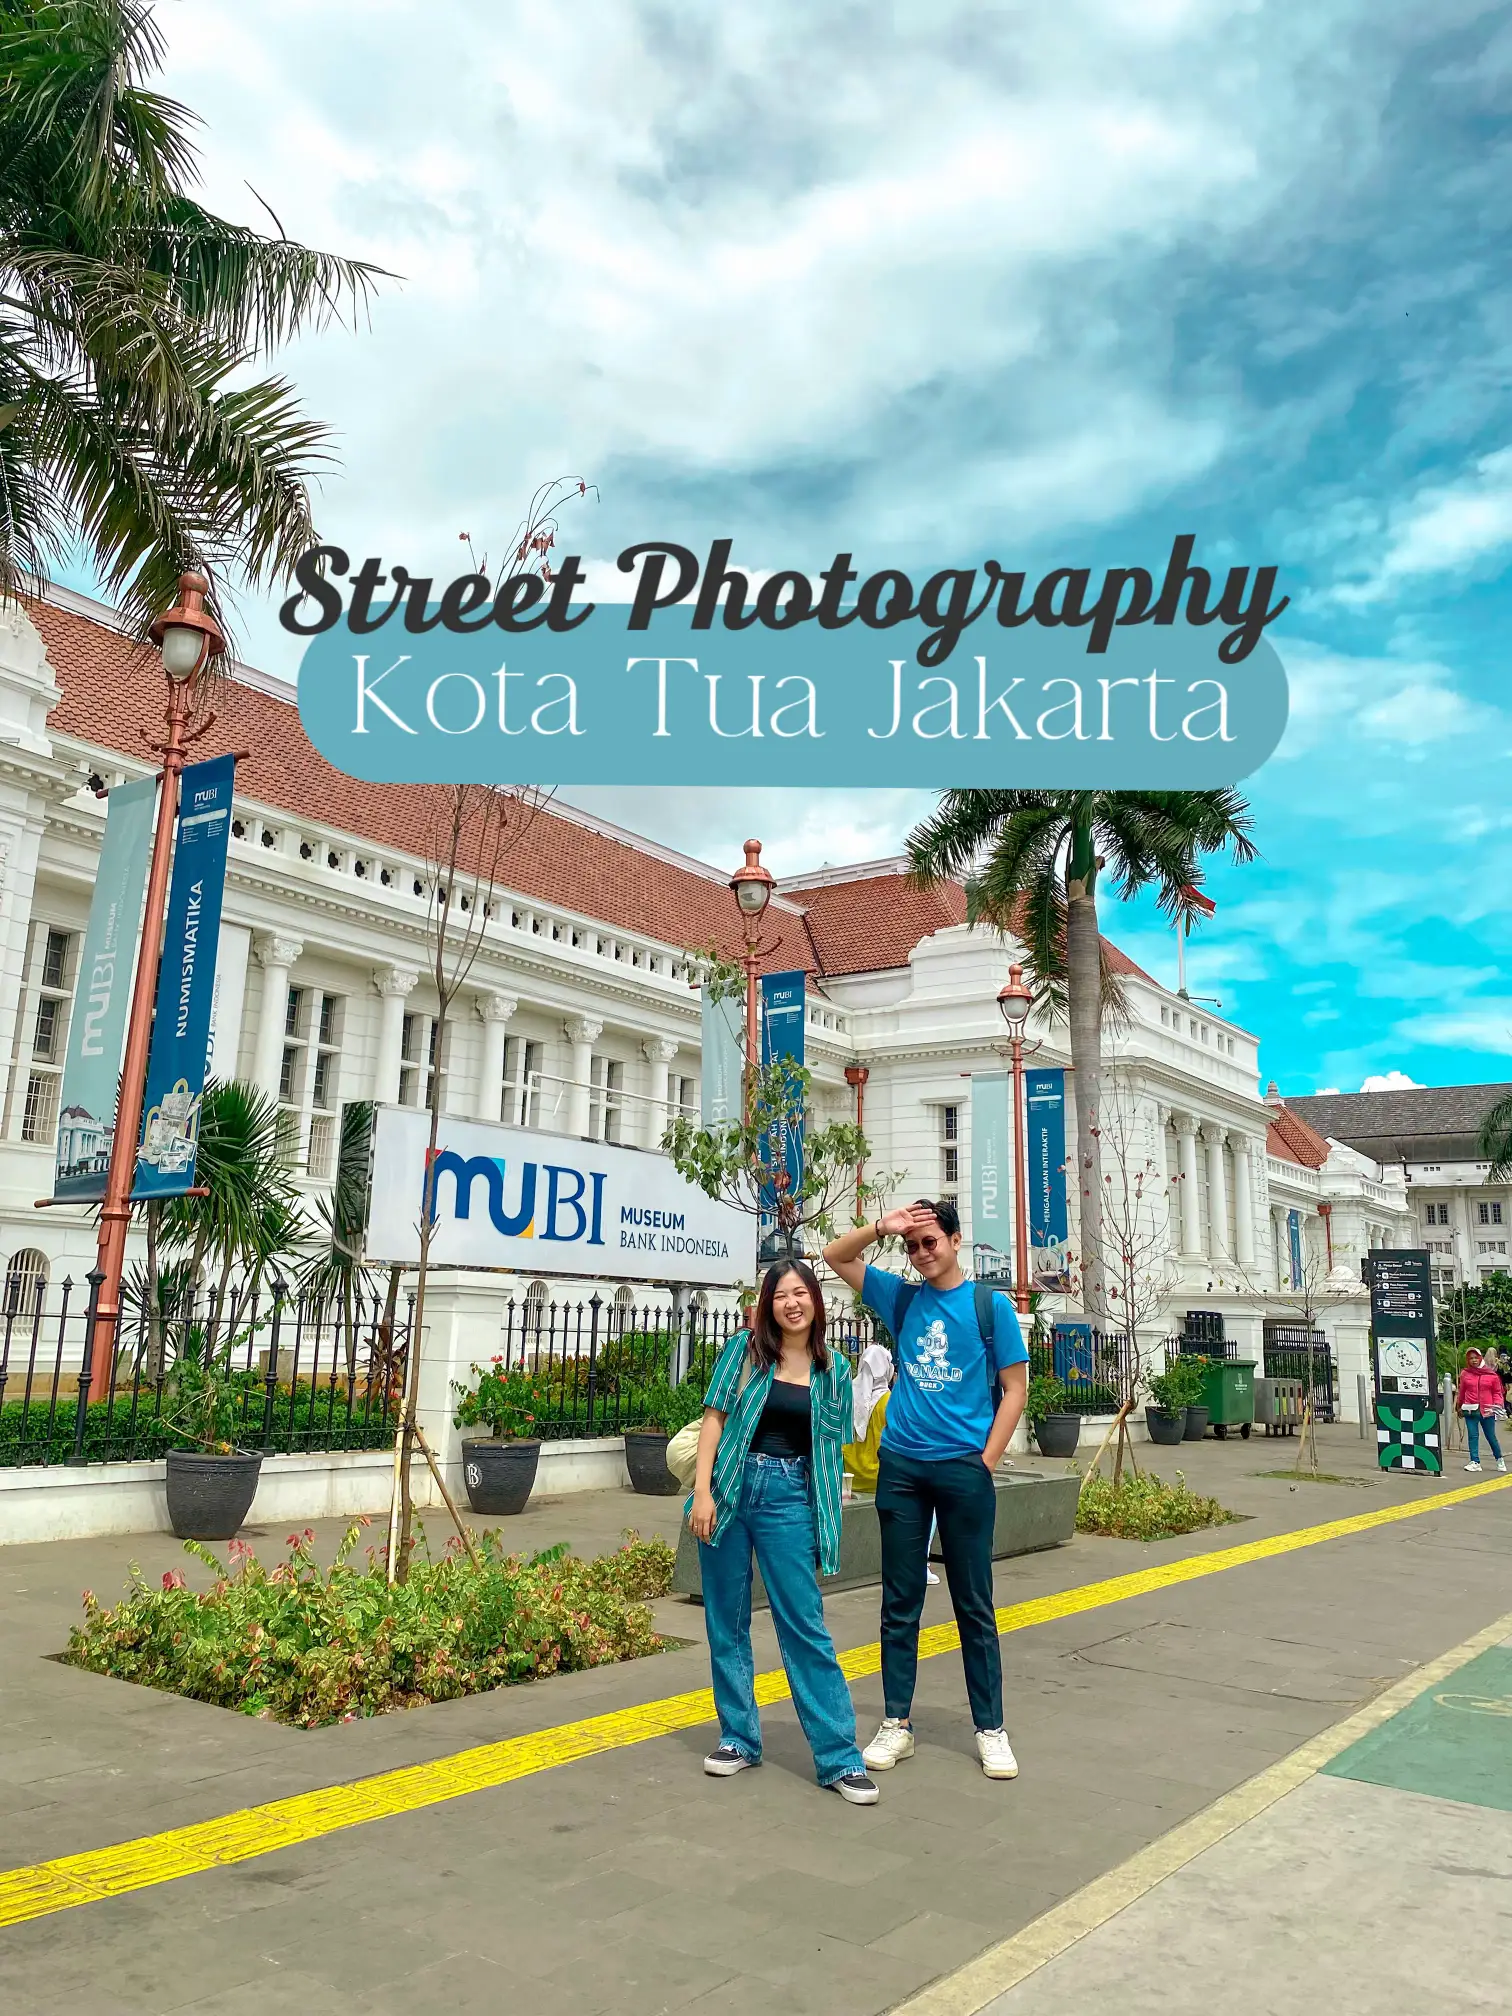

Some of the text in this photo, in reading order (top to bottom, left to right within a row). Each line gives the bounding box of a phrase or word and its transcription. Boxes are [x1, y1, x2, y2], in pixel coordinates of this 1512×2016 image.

[105, 903, 117, 950] MUSEUM
[175, 878, 204, 1038] NUMISMATIKA
[212, 974, 221, 1009] INDONESIA
[1043, 1170, 1051, 1223] PENGALAMAN
[620, 1206, 684, 1230] MUSEUM
[620, 1230, 729, 1258] BANK INDONESIA
[919, 1382, 938, 1390] DUCK
